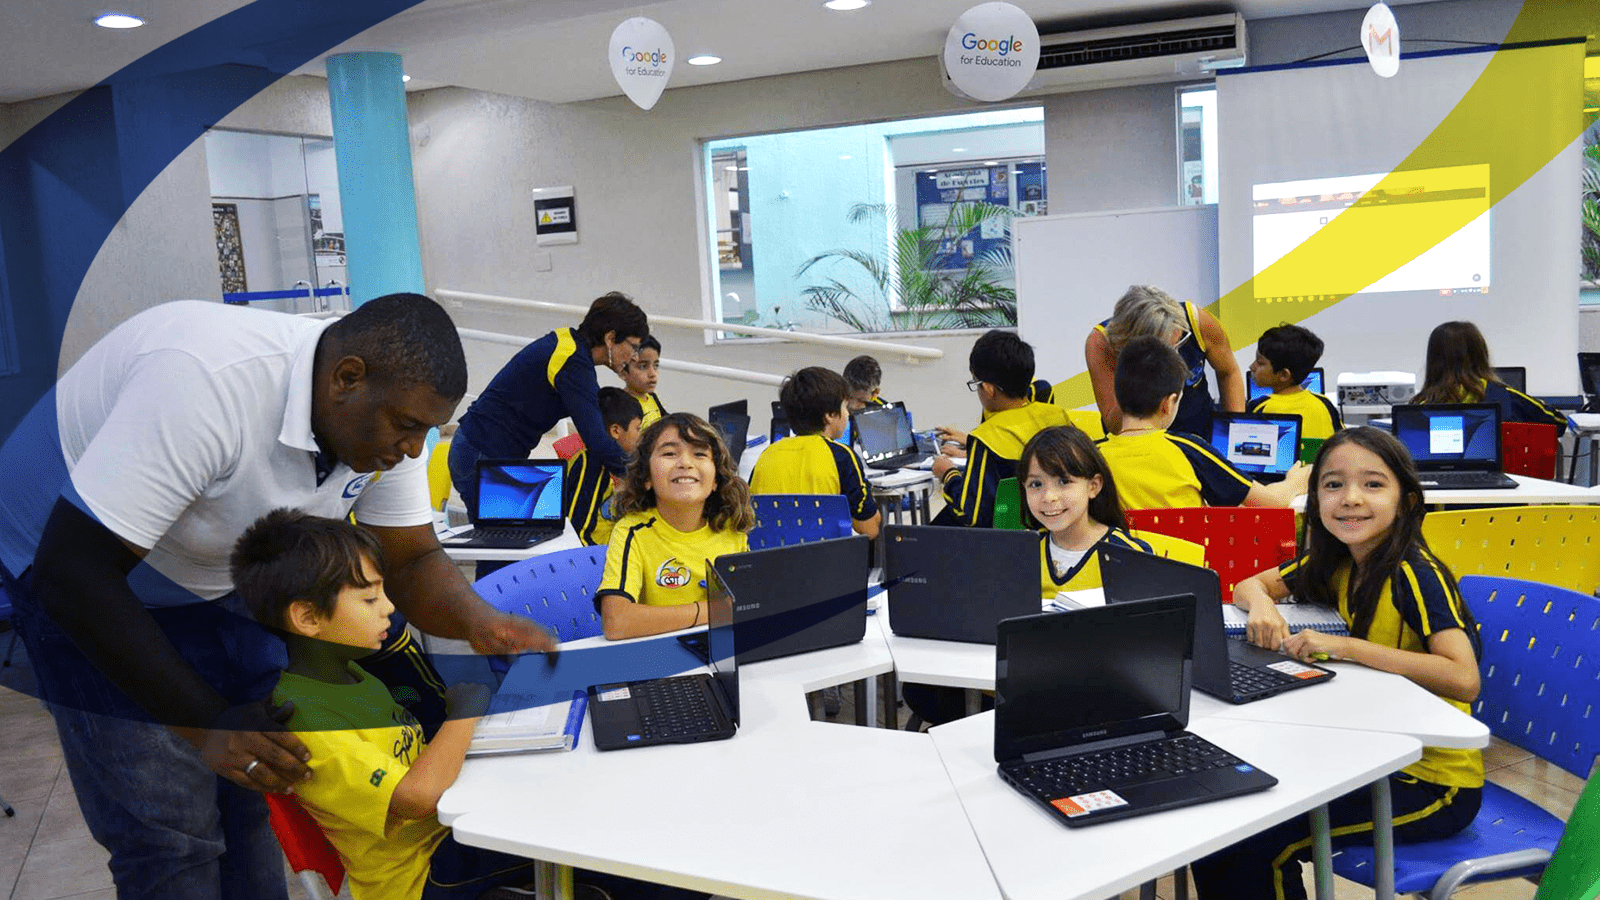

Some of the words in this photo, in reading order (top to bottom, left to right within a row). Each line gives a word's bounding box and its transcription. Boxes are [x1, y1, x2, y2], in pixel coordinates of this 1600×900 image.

[962, 33, 1022, 56] Google
[622, 46, 667, 67] Google
[960, 55, 974, 65] for
[975, 56, 1022, 67] Education
[626, 67, 637, 76] for
[736, 602, 760, 612] MSUNG
